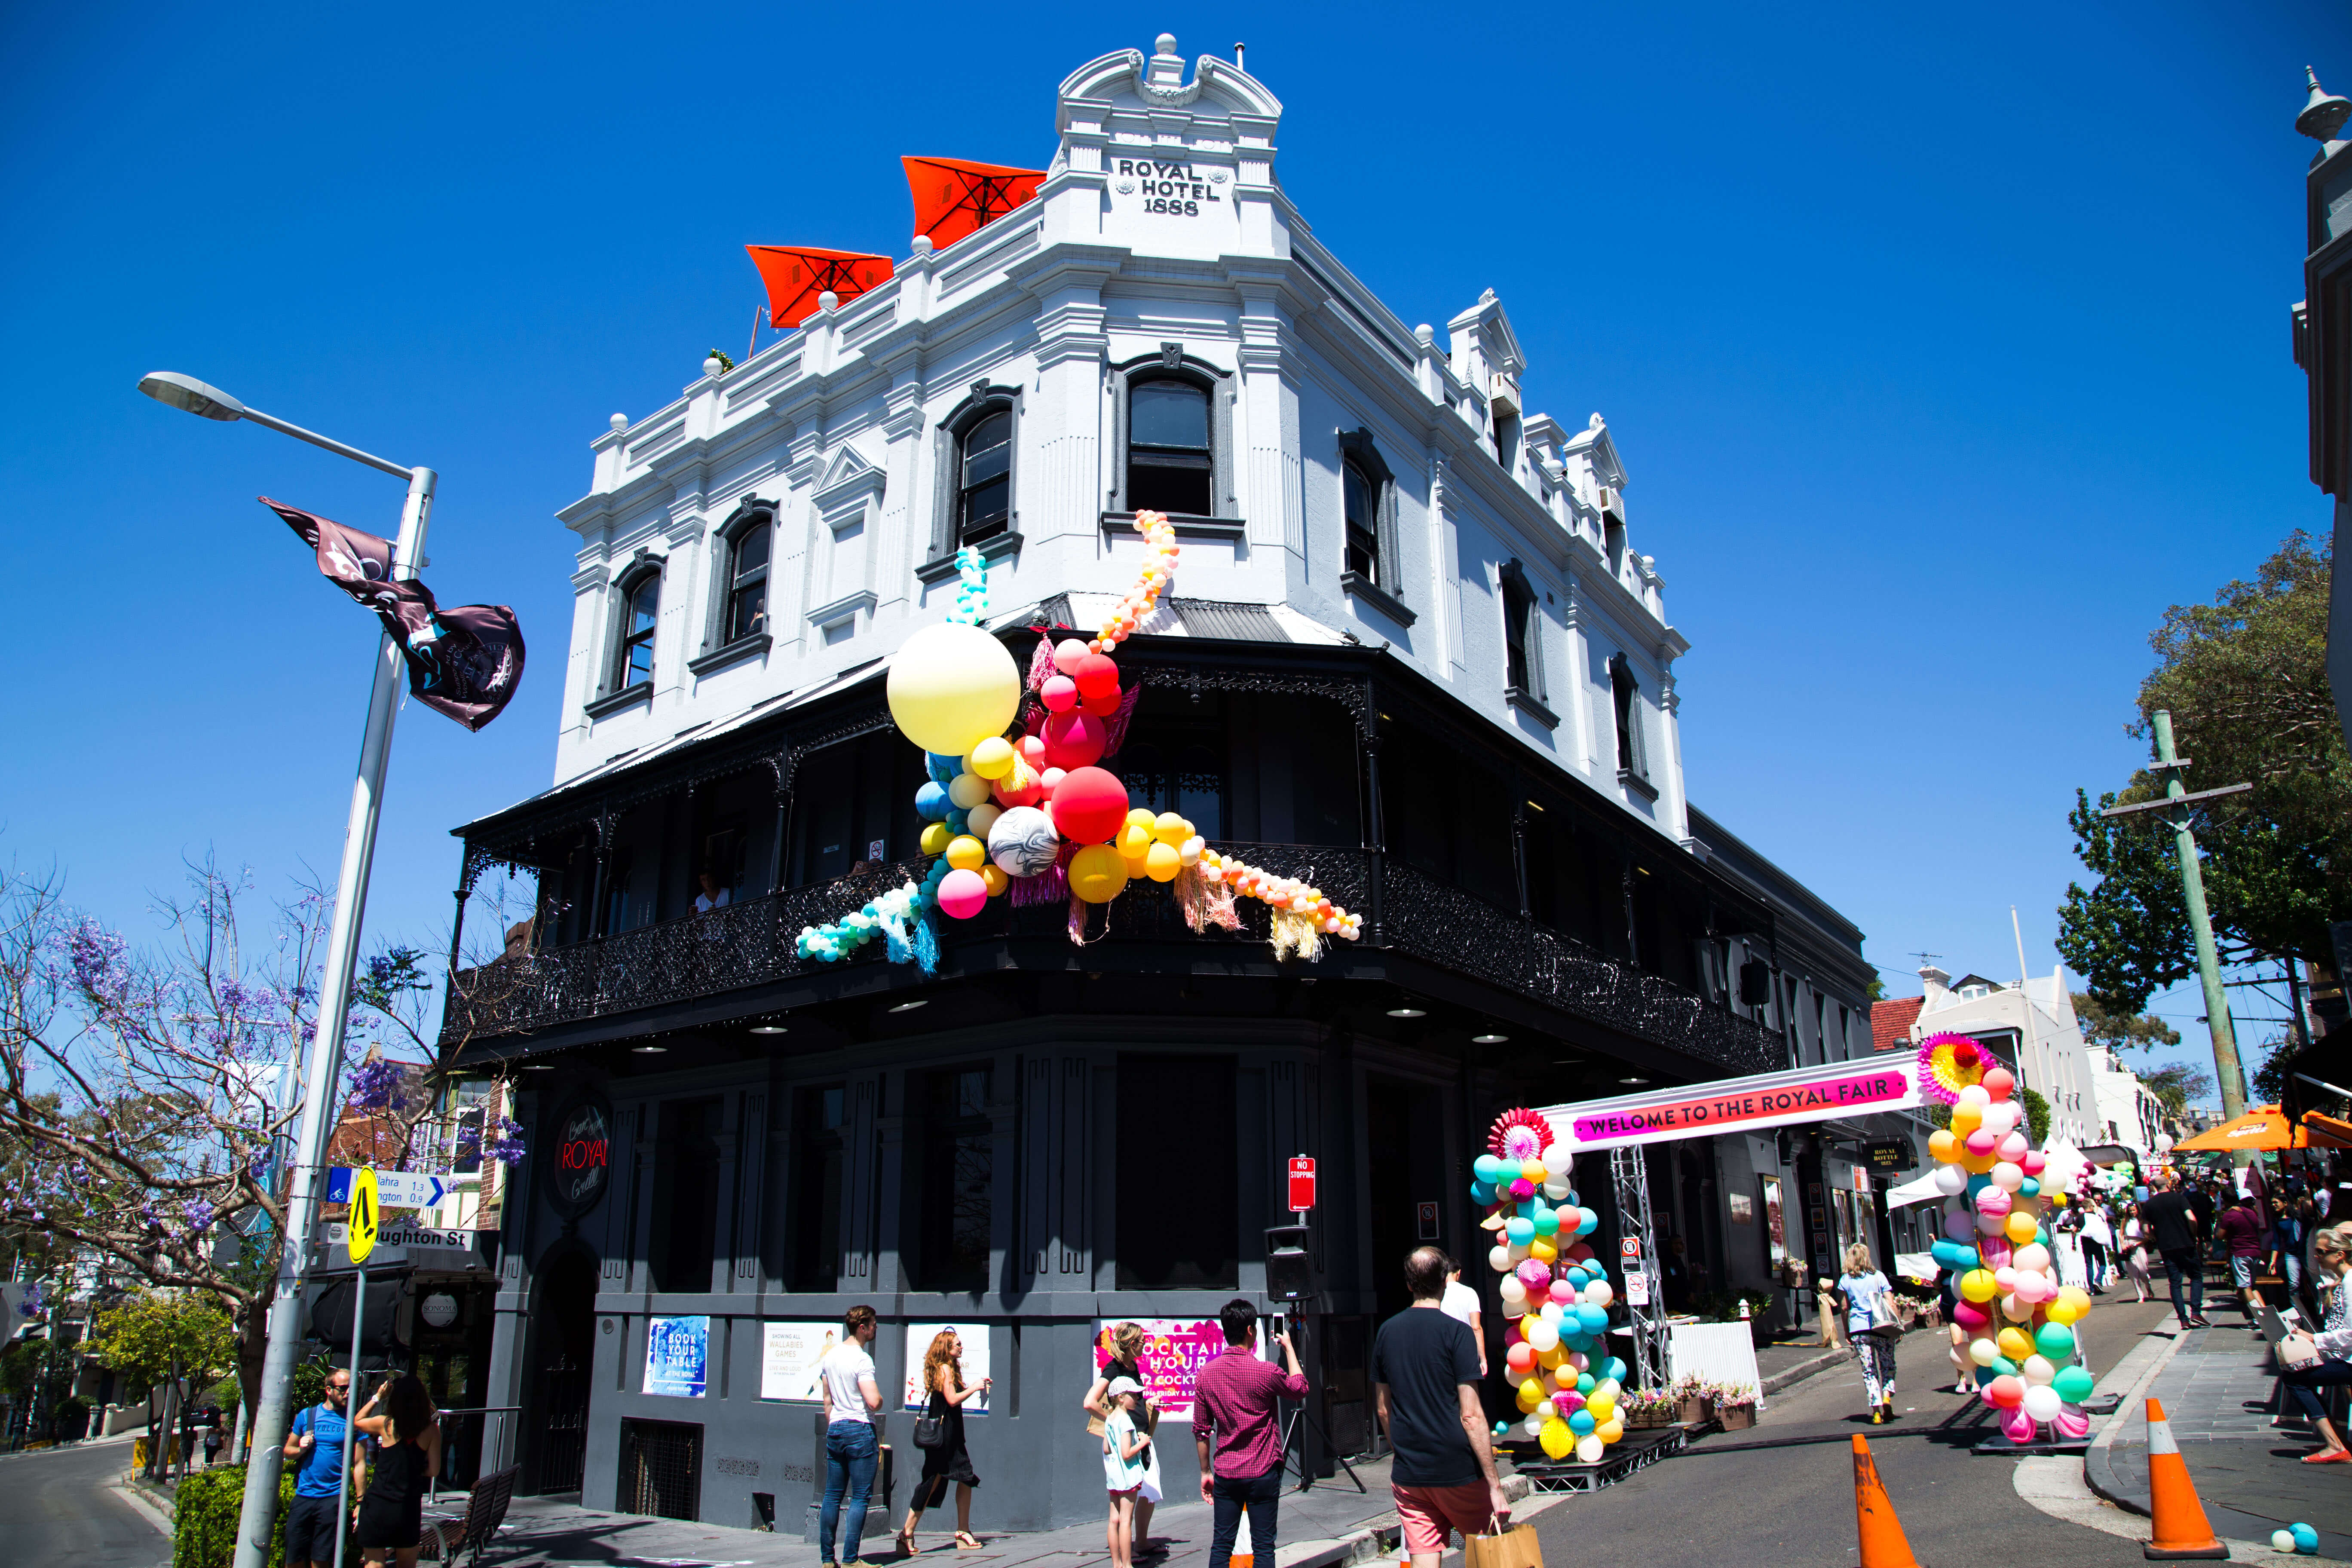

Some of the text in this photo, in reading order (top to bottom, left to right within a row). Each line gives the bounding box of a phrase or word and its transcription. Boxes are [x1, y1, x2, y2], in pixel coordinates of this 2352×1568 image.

[1120, 159, 1203, 182] ROYAL
[1142, 179, 1220, 202] HOTEL
[1144, 199, 1198, 217] 1888
[1590, 1080, 1888, 1135] WELOME TO THE ROYAL FAIR
[563, 1139, 608, 1169] ROYAL
[1297, 1161, 1307, 1169] NO
[413, 1182, 424, 1191] 1.3
[572, 1166, 600, 1199] Grill
[410, 1193, 423, 1203] 0.9
[447, 1231, 465, 1246] St
[669, 1333, 696, 1344] BOOK
[669, 1345, 695, 1355] YOUR
[666, 1356, 696, 1367] TABLE
[1157, 1375, 1196, 1384] COCKT
